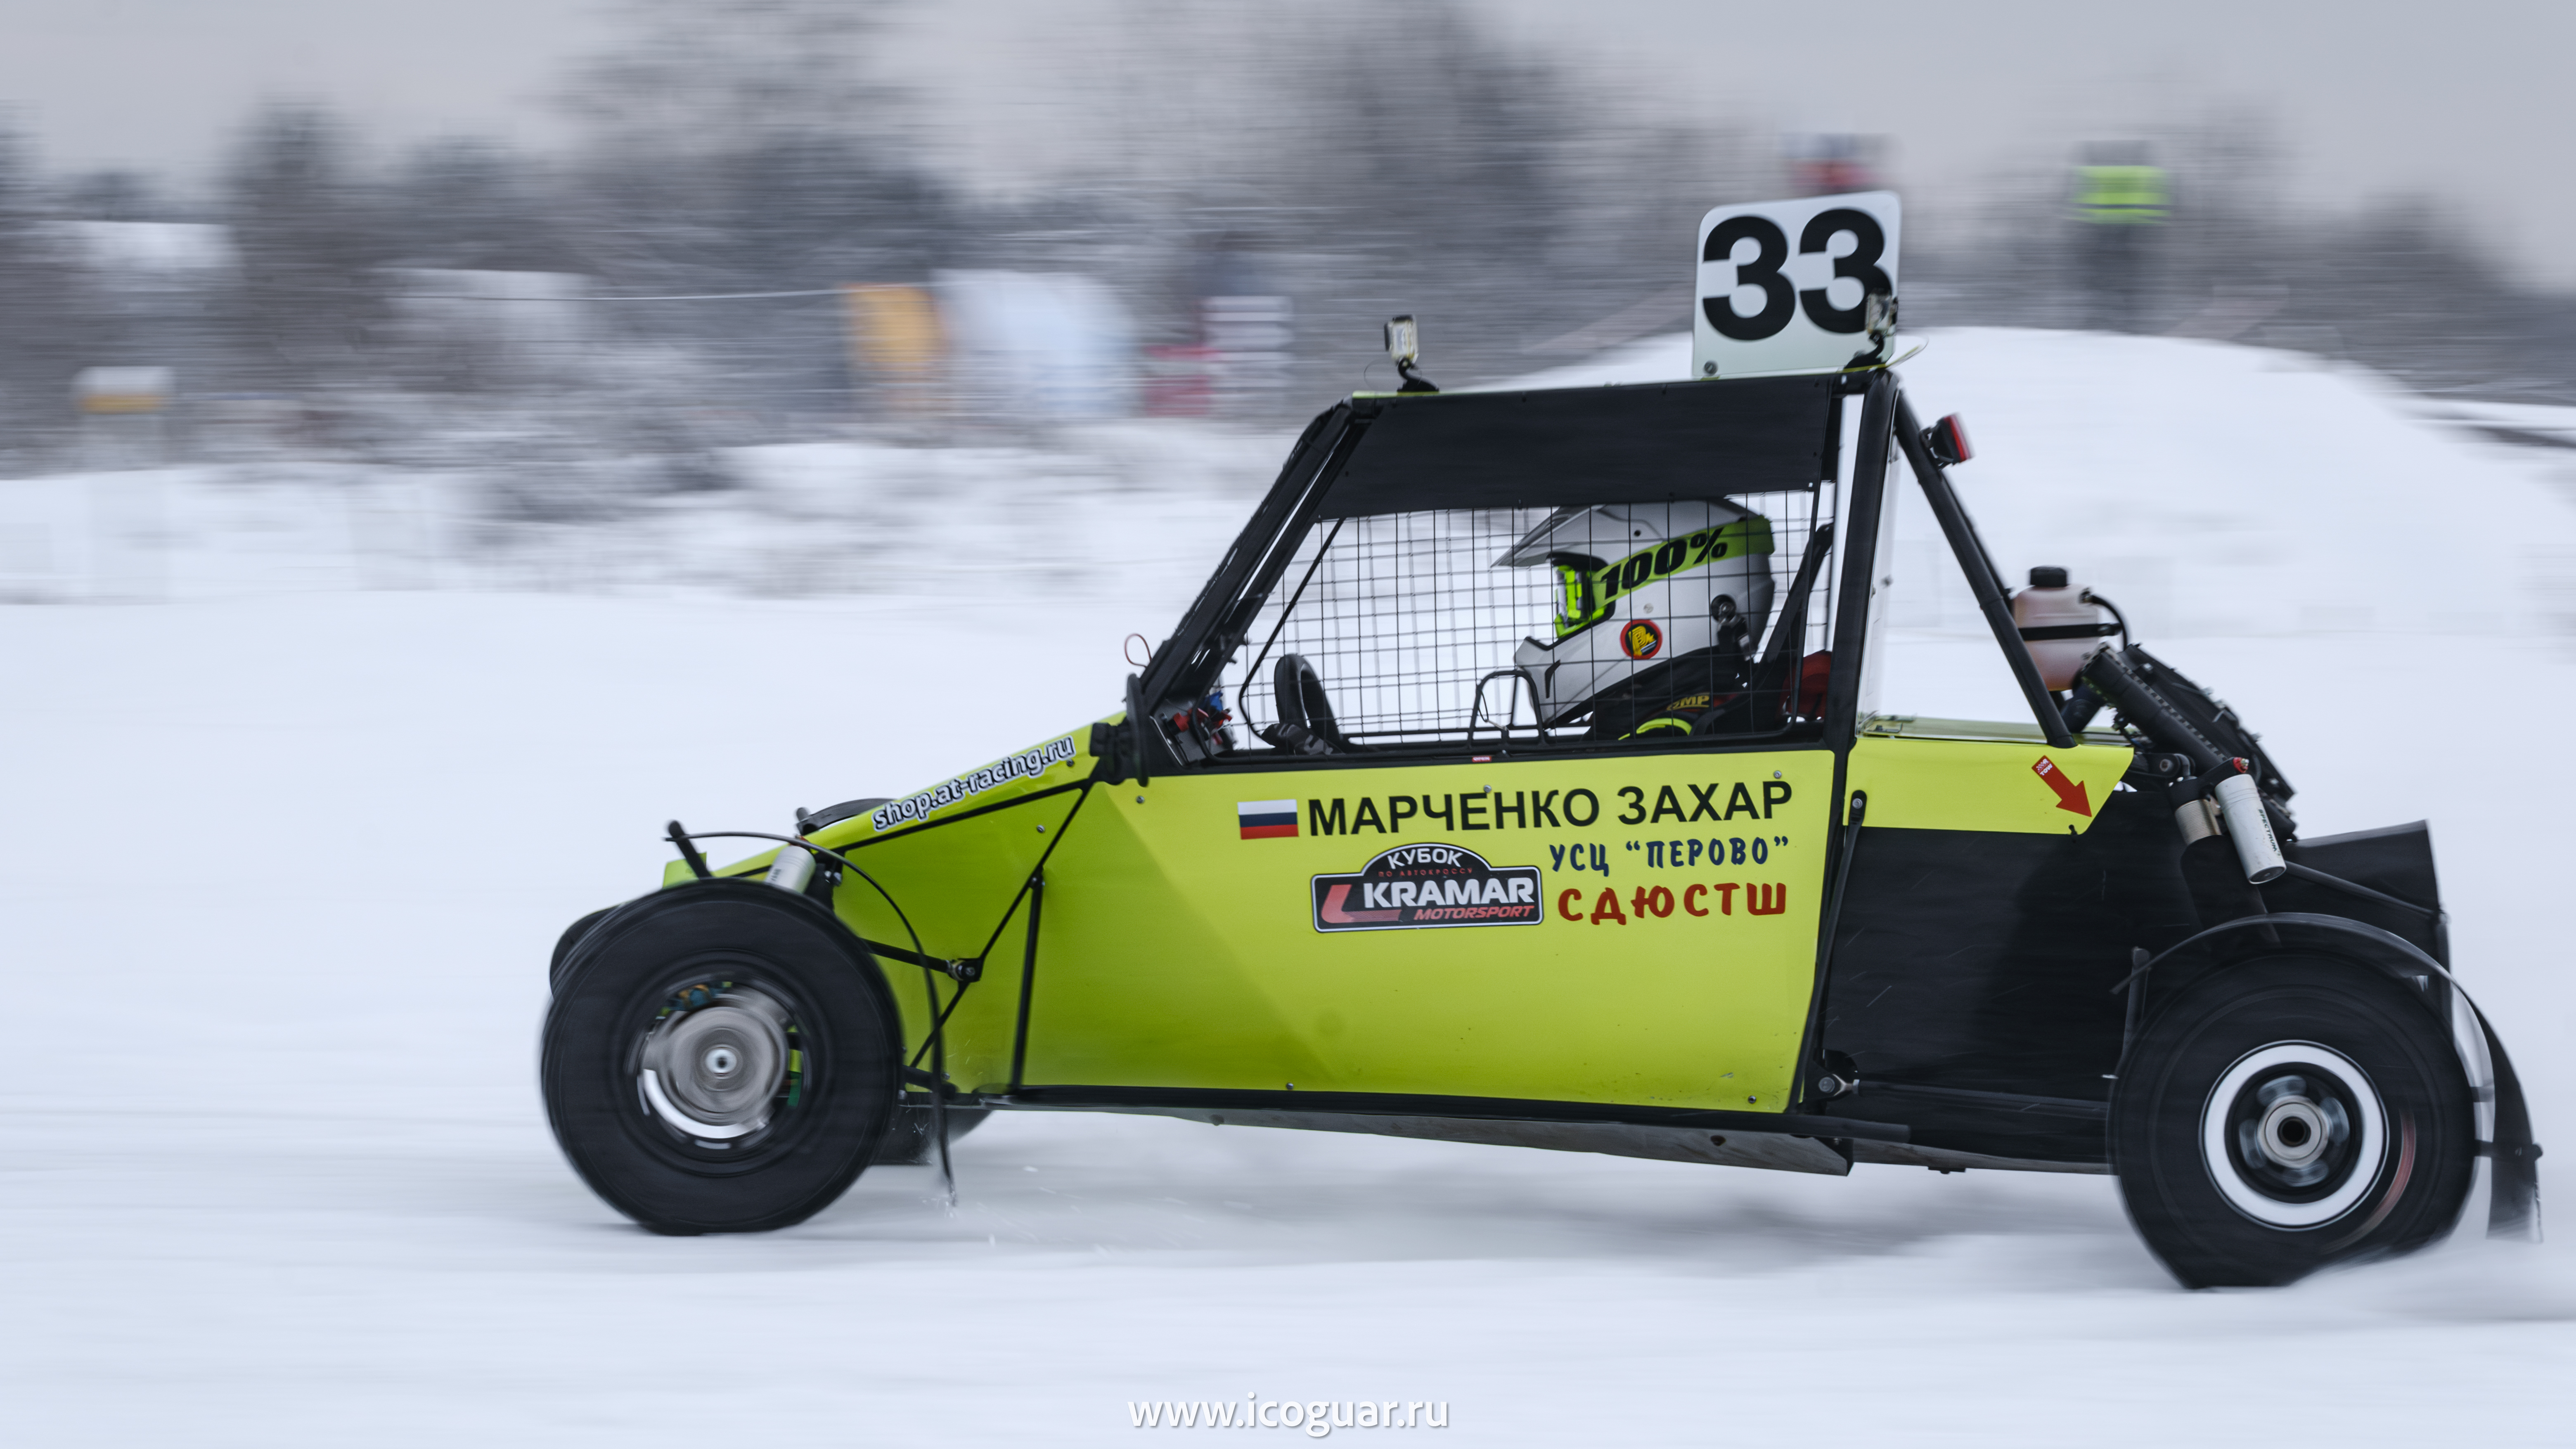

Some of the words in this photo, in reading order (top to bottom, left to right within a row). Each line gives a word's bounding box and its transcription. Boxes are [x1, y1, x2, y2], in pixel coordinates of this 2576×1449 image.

[1703, 208, 1892, 340] 33
[1600, 527, 1728, 600] 100%
[873, 736, 1076, 831] shop.at-racing.ru
[2039, 763, 2053, 776] TOW
[1309, 788, 1600, 837] МАРЧЕНКО
[1617, 780, 1792, 825] ЗАХАР
[1387, 848, 1463, 869] КУБОК
[1399, 867, 1473, 876] АВТОКРОССУ
[1549, 843, 1609, 877] УСЦ
[1626, 836, 1788, 869] “ПЕРОВО”
[1363, 877, 1535, 908] KRAMAR
[1413, 905, 1535, 921] MOTORSPORT
[1558, 882, 1787, 926] СДЮСТШ
